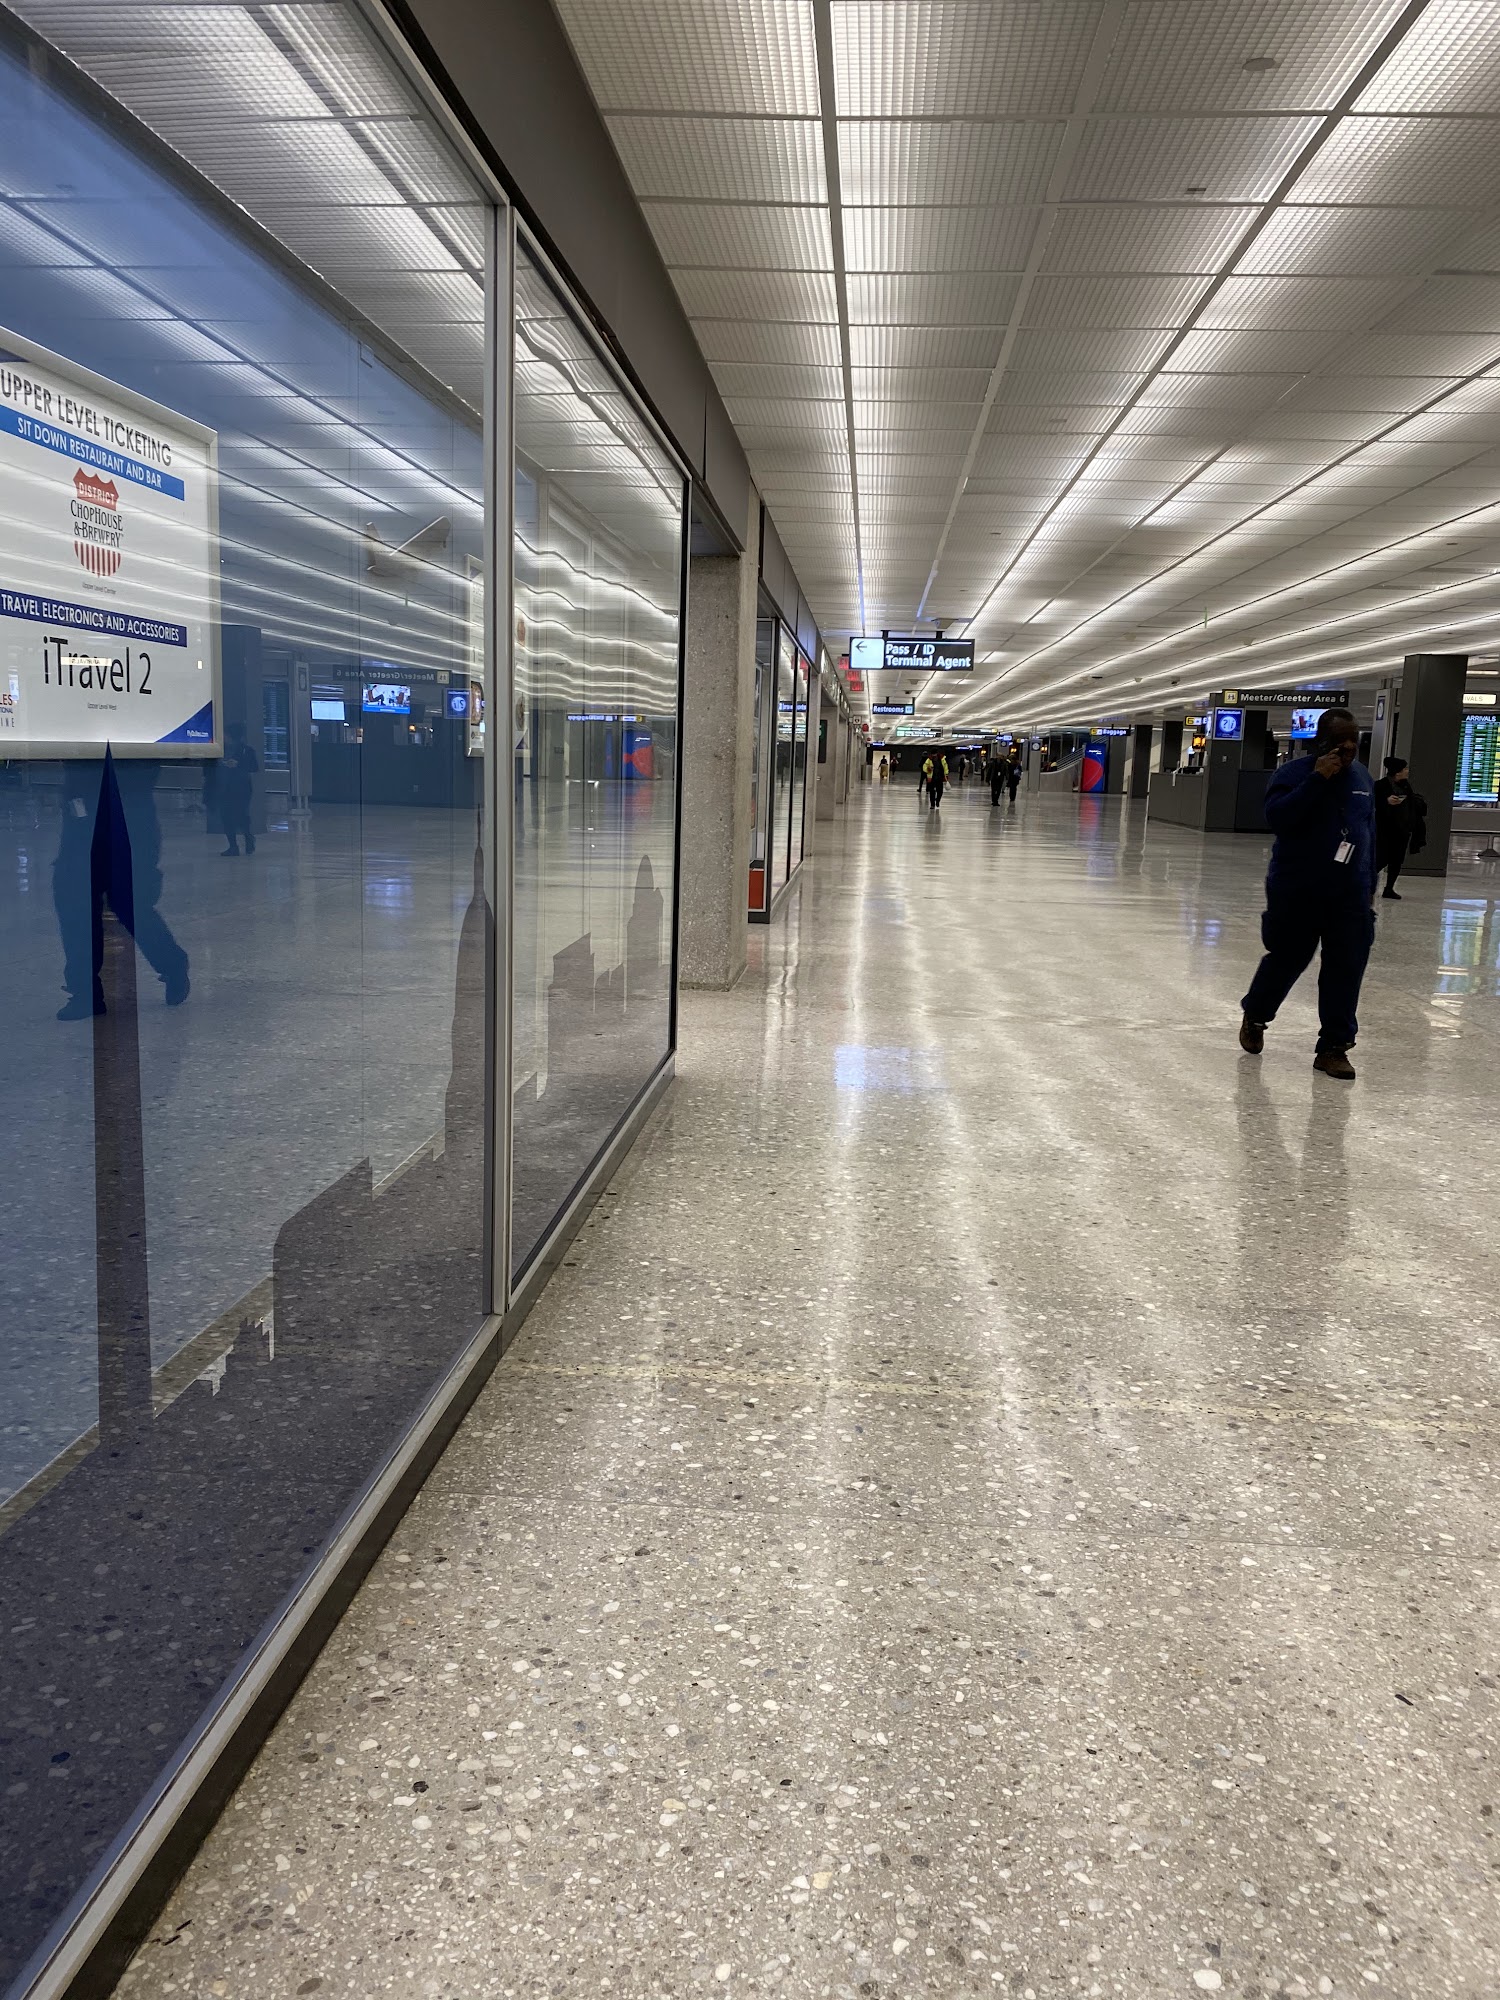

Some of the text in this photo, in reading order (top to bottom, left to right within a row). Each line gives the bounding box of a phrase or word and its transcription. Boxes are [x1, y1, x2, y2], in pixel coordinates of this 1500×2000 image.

[1, 369, 172, 466] UPPER LEVEL TICKETING
[17, 417, 162, 488] SIT DOWN RESTAURANT AND BAR
[78, 482, 115, 505] DISTRICT
[1, 593, 180, 642] TRAVEL ELECTRONICS AND ACCESSORIES
[885, 644, 910, 655] Pass
[922, 644, 936, 655] ID
[43, 635, 152, 695] iTravel 2
[885, 655, 971, 669] Terminal Agent
[1240, 693, 1346, 703] Meeter/Greeter Area 6
[873, 705, 905, 713] Restrooms
[1465, 714, 1497, 722] ARRIVALS
